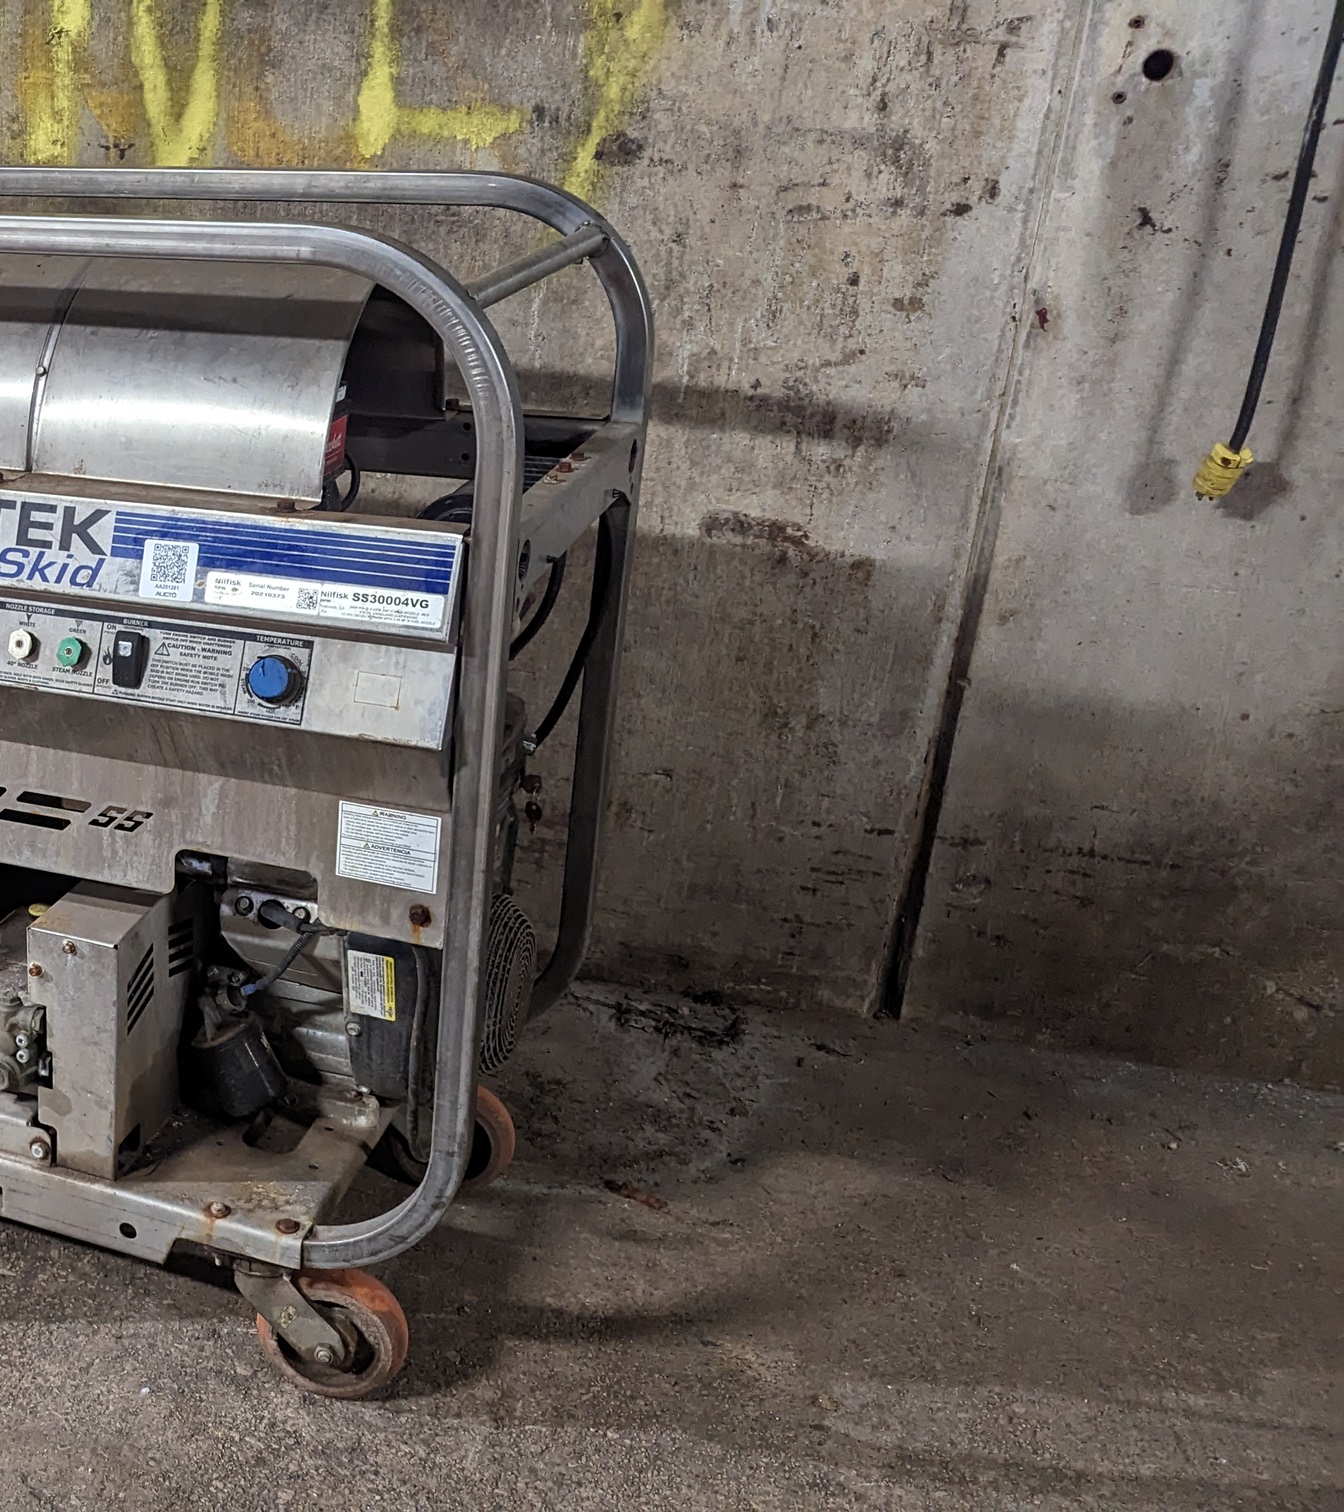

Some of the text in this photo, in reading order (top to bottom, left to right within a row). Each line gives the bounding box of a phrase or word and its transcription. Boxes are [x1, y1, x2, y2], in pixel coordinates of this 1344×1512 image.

[214, 577, 242, 587] Nilfisk
[266, 584, 290, 592] Number
[320, 590, 349, 600] Nilfisk
[352, 592, 430, 609] SS30004VG
[6, 603, 55, 615] NOZZLE STORAGE
[106, 623, 117, 631] ON
[123, 618, 149, 627] BURNER
[256, 635, 304, 647] TEMPERATURE
[167, 642, 196, 651] CAUTION
[201, 647, 233, 656] WARNING
[179, 651, 201, 659] SAFETY
[17, 661, 38, 669] NOZZLE
[52, 666, 93, 677] STEAM NOZZLE
[96, 677, 110, 685] OFF
[379, 811, 407, 820] WARNING
[370, 843, 411, 856] ADVERTENCIA
